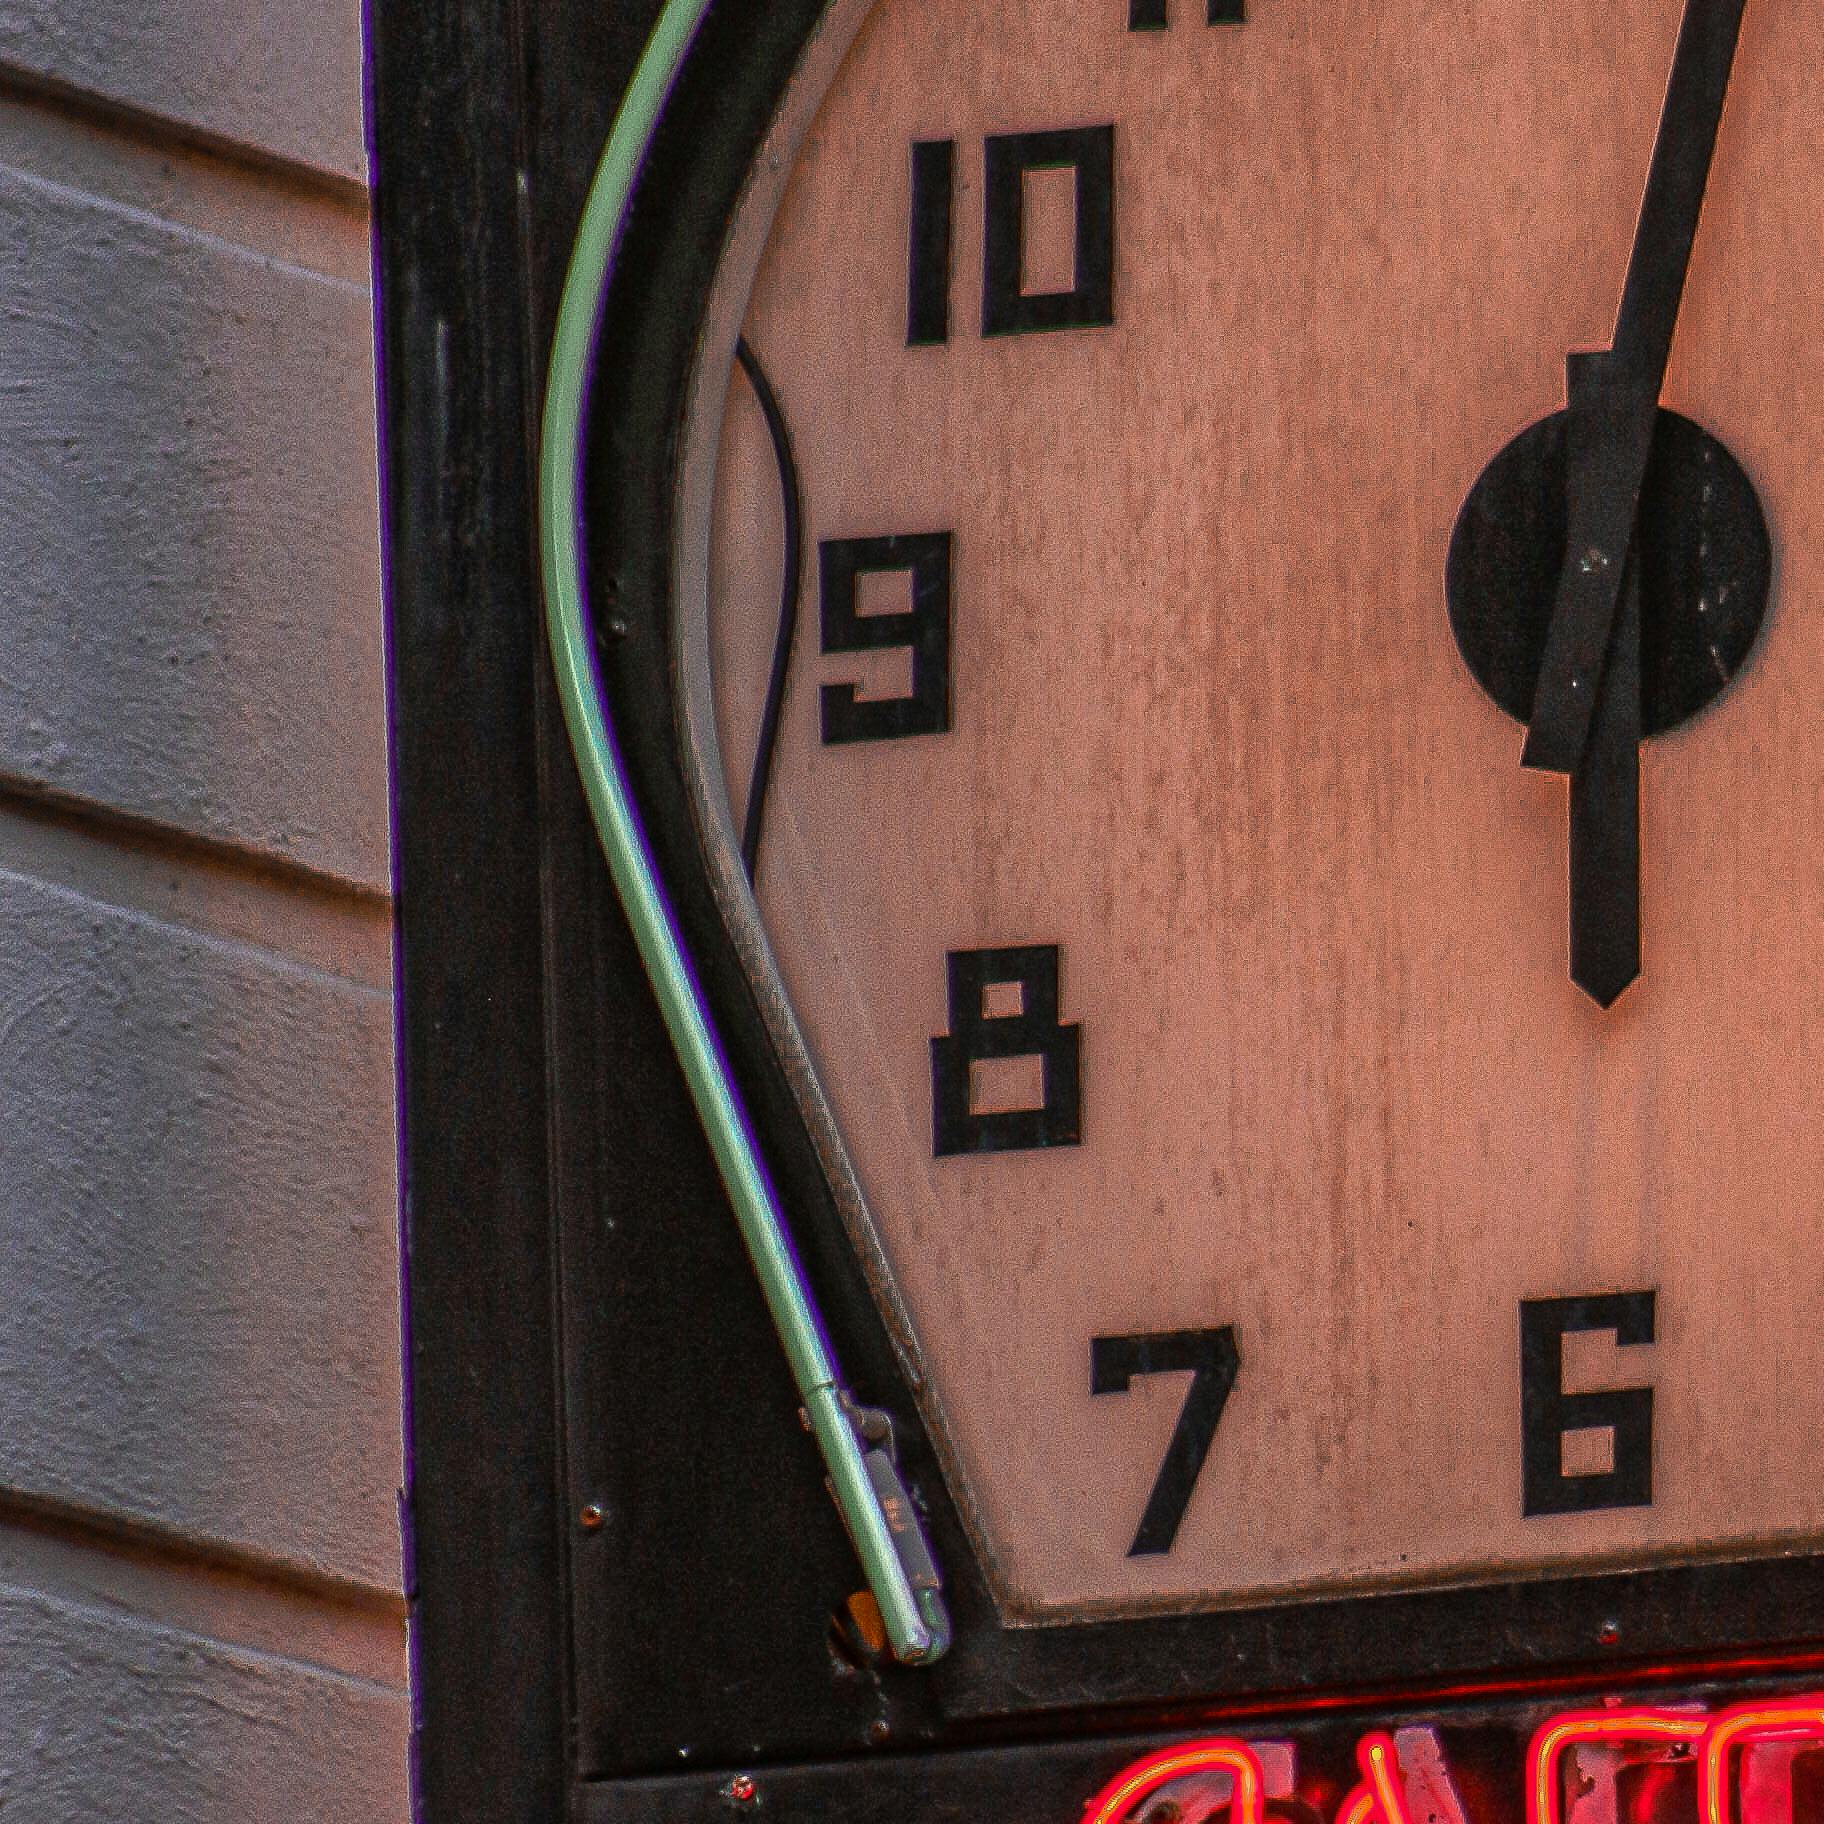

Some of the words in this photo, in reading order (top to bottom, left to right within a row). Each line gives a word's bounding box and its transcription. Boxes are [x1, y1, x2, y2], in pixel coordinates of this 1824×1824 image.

[906, 123, 1115, 346] 10
[818, 532, 952, 746] 9
[931, 944, 1083, 1158] 8
[1089, 1324, 1242, 1558] 7
[1521, 1289, 1657, 1518] 6
